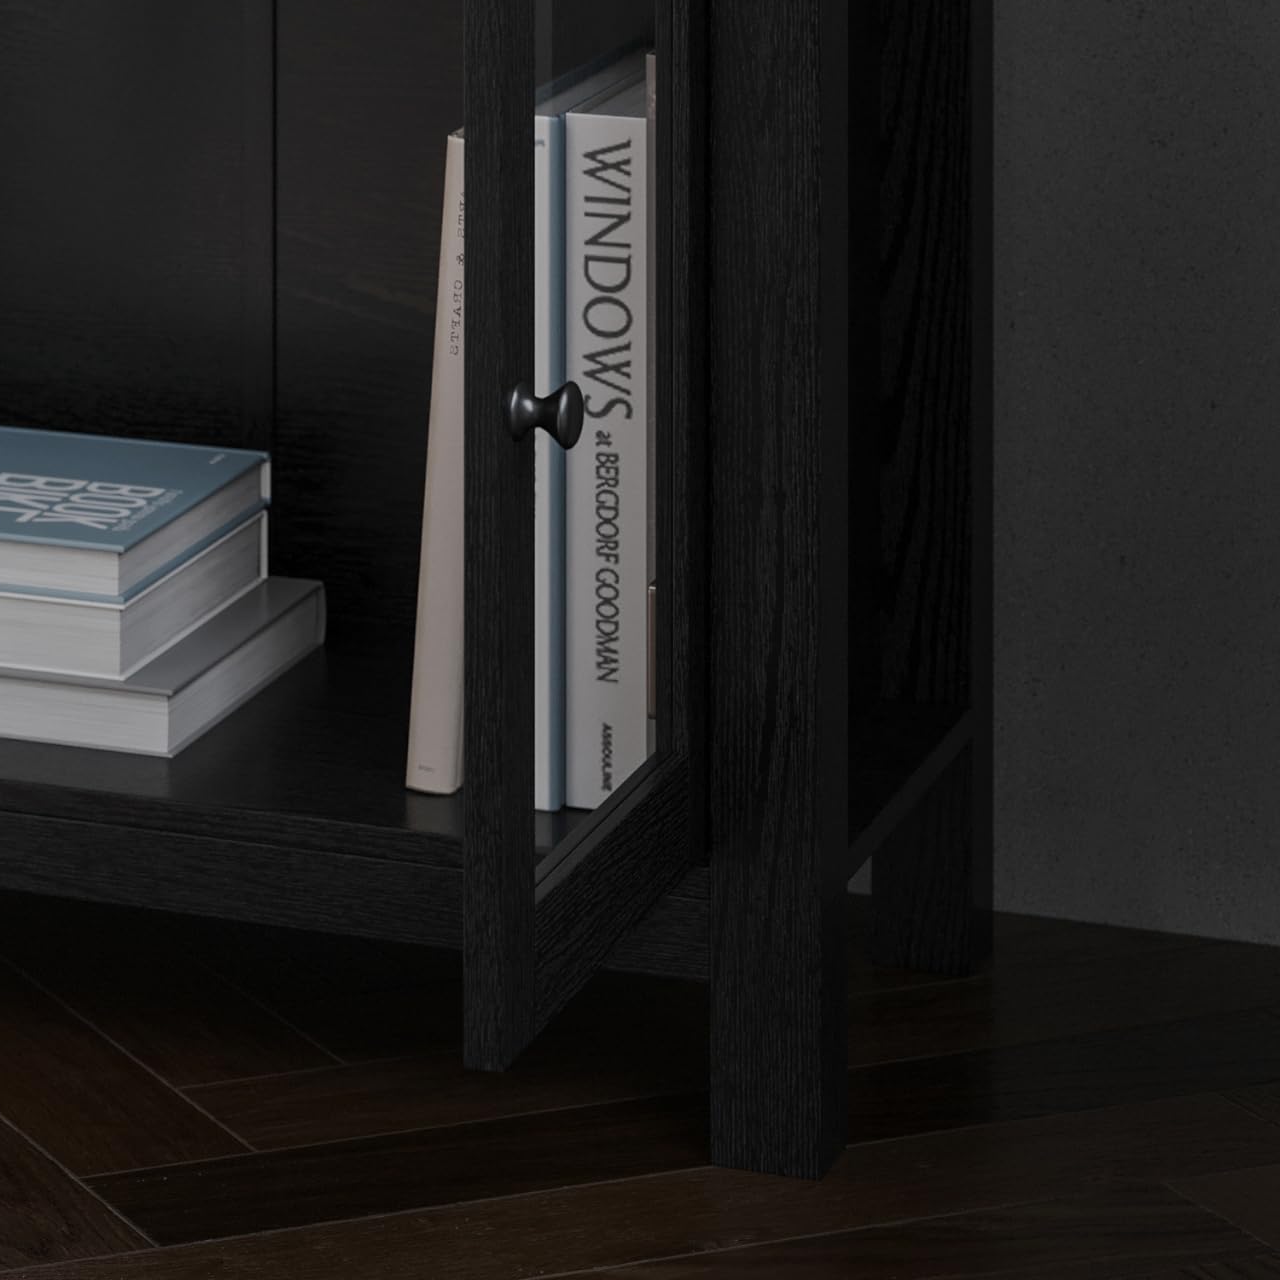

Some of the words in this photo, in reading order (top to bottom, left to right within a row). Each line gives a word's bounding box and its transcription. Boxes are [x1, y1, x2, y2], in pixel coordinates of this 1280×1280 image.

[582, 139, 633, 420] WINDOWS
[595, 430, 612, 447] at
[595, 452, 620, 564] BERGDORF
[595, 568, 620, 684] GOODMAN
